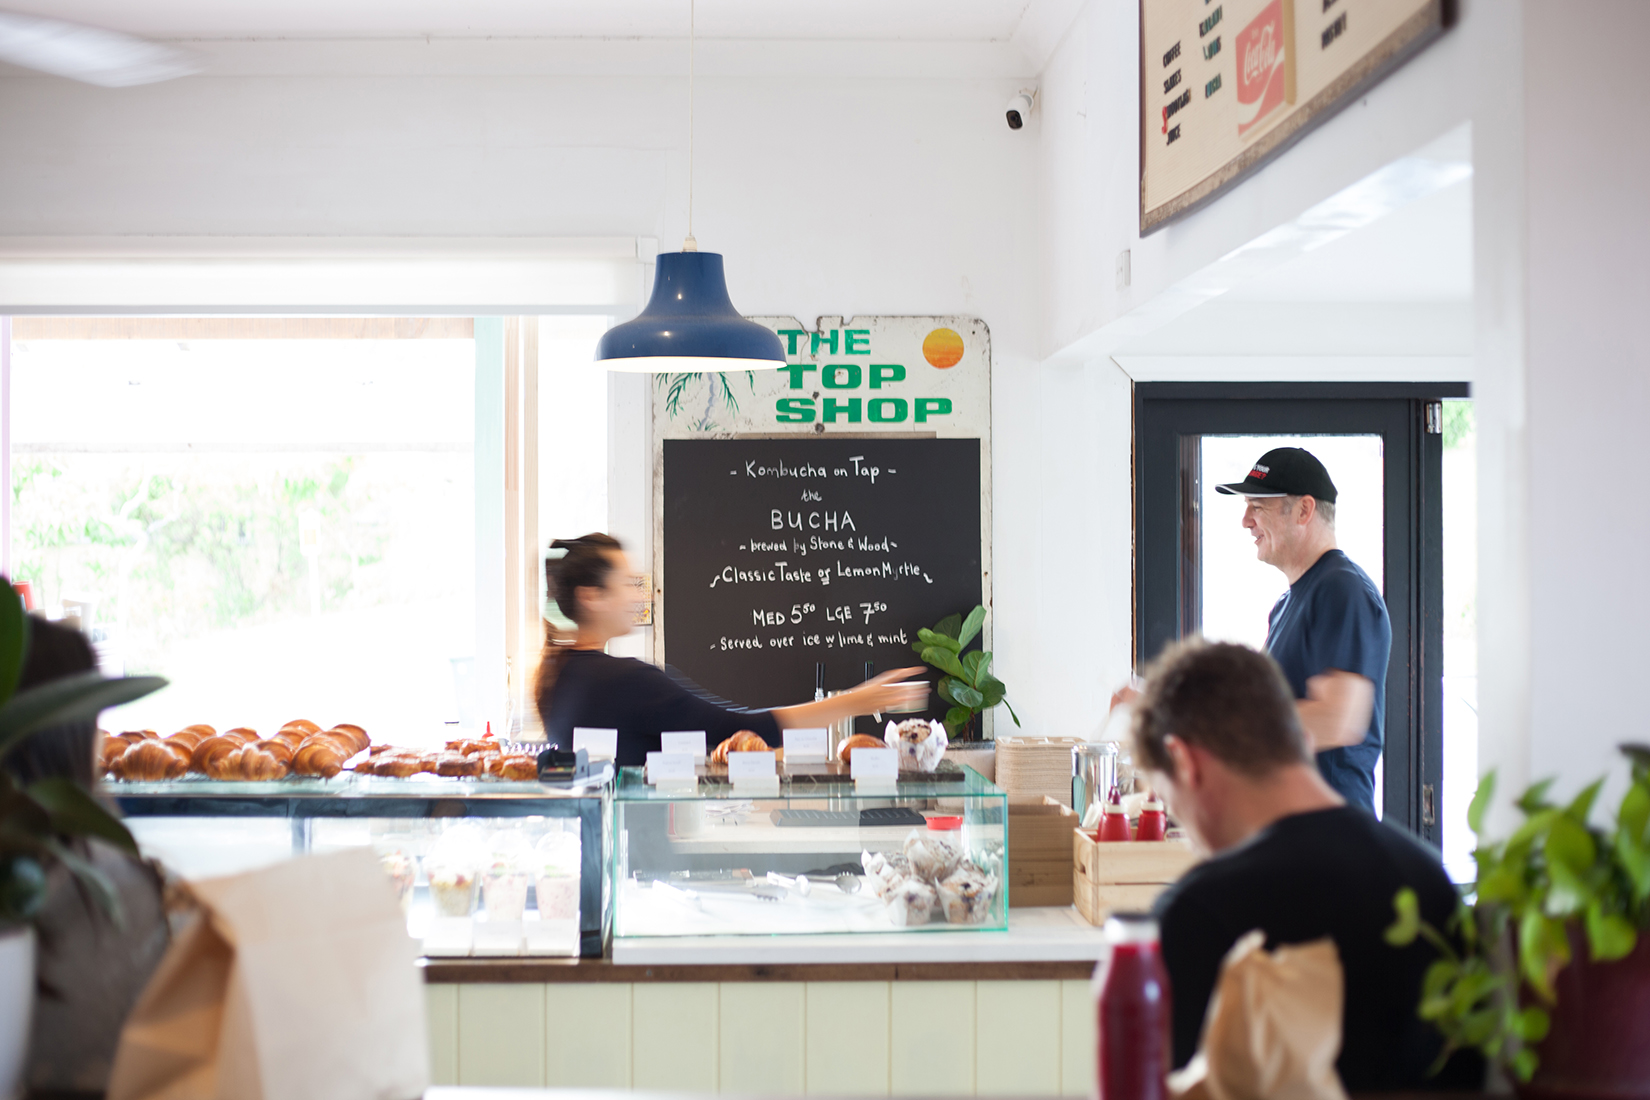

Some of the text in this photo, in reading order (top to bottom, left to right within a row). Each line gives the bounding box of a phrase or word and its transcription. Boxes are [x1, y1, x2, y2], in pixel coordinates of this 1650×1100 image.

[1163, 40, 1181, 68] COFFEE
[777, 329, 871, 355] THE
[776, 364, 906, 389] TOP
[775, 397, 953, 423] SHOP
[745, 455, 880, 484] Kombucha on Tap
[801, 489, 822, 502] the
[771, 508, 856, 532] BUCHA
[750, 538, 787, 552] brewed
[793, 537, 807, 556] by
[810, 535, 844, 551] Stone
[722, 565, 776, 584] Classic
[774, 561, 812, 584] Taste
[837, 560, 881, 577] Lemon
[882, 561, 920, 581] Myrtle
[752, 609, 786, 627] MED
[826, 605, 852, 624] LGE
[720, 636, 763, 651] Served
[769, 635, 794, 649] over
[803, 631, 820, 646] ice
[838, 630, 864, 648] lime
[878, 628, 908, 646] mint
